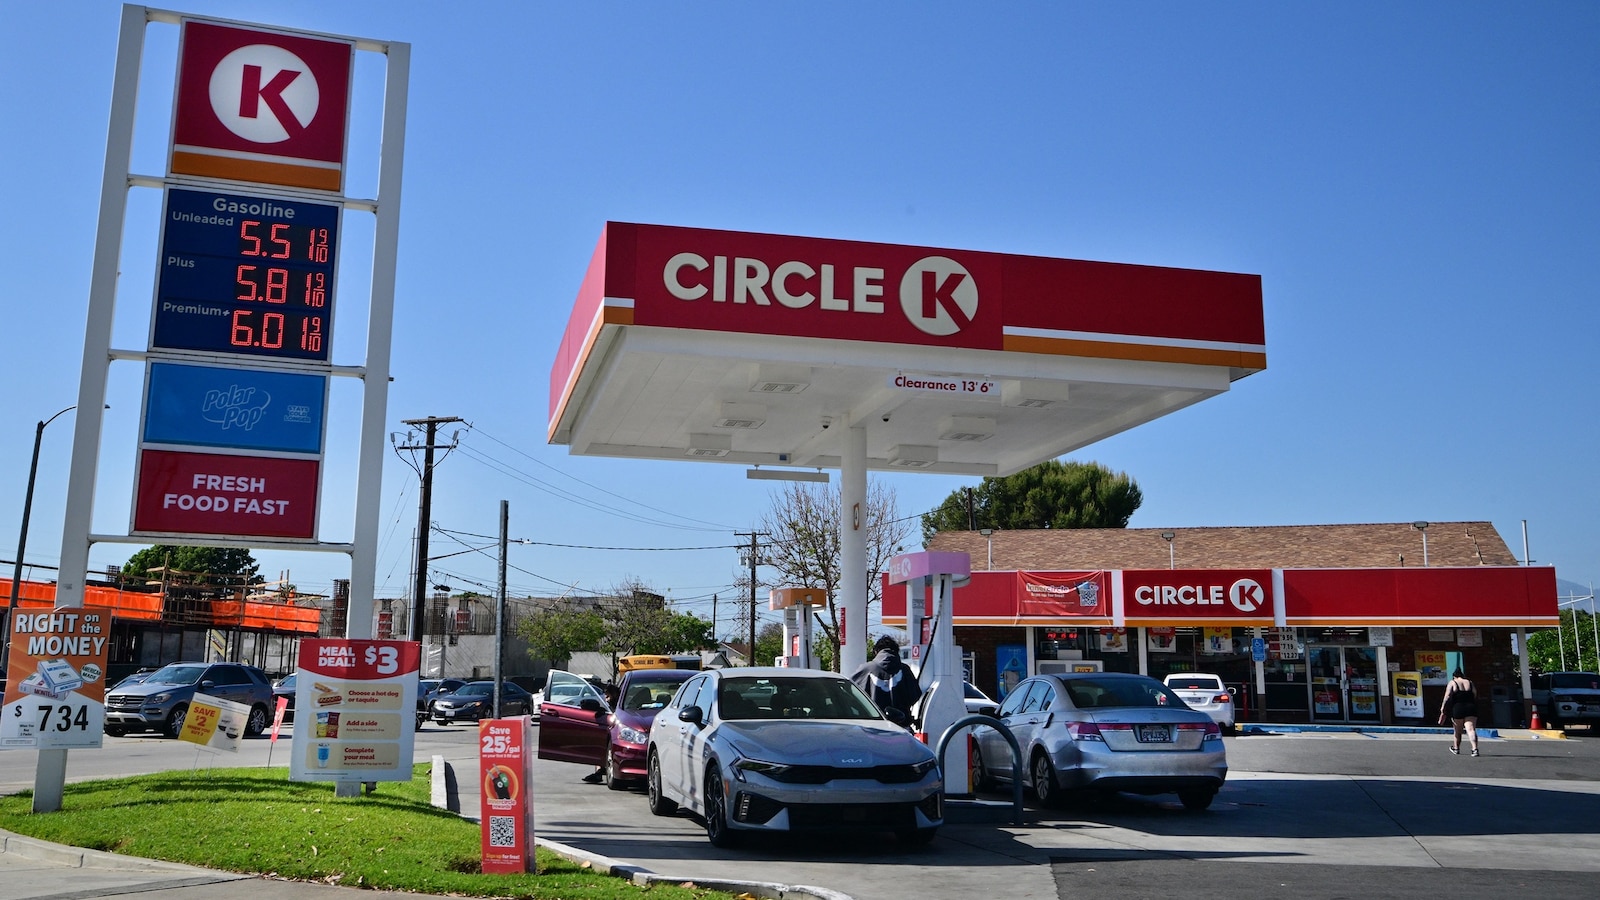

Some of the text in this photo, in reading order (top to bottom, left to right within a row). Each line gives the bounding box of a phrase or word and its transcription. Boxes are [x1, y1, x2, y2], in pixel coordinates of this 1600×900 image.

[234, 60, 309, 142] K
[213, 198, 295, 218] Gasoline
[172, 211, 234, 226] Unleaded
[168, 256, 195, 268] Plus
[663, 252, 974, 333] CIRCLE K
[894, 376, 957, 391] Clearance
[962, 381, 978, 392] 13'
[202, 384, 256, 411] Polar
[222, 407, 262, 431] Pop
[284, 415, 311, 423] LONGER
[192, 474, 265, 493] FRESH
[163, 493, 290, 515] FOOD FAST
[1135, 584, 1262, 610] CIRCLE K
[15, 613, 79, 633] RIGHT
[84, 614, 100, 622] on
[81, 623, 101, 633] the
[27, 636, 106, 656] MONEY
[318, 657, 356, 667] DEAL!
[319, 646, 399, 674] MEAL $3
[387, 690, 399, 698] dog
[15, 704, 89, 732] $ 7.34
[193, 706, 216, 718] SAVE
[195, 715, 207, 727] $2
[489, 726, 511, 735] Save
